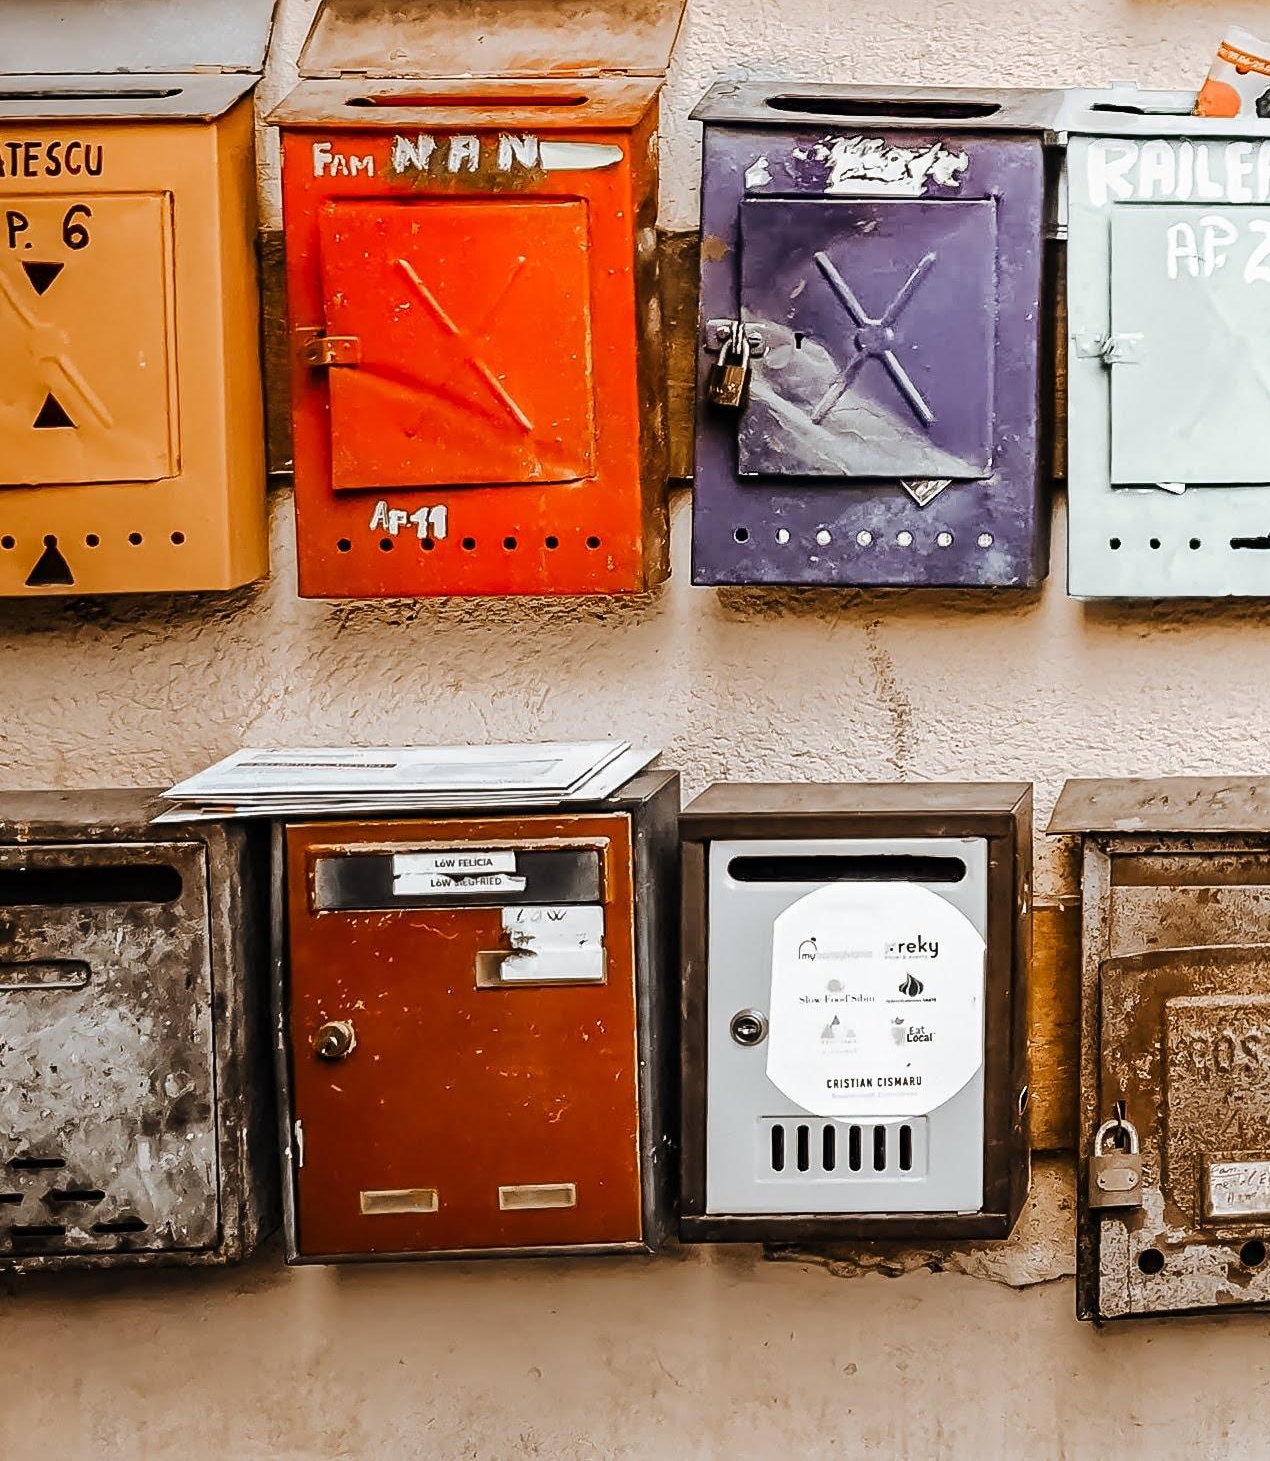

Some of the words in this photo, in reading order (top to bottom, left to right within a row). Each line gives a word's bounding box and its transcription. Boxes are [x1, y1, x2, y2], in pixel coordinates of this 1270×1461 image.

[62, 203, 93, 251] 6
[458, 858, 494, 868] FELICIA
[909, 1026, 925, 1036] Eat
[906, 1033, 933, 1043] Local
[826, 1078, 873, 1089] CRISTIAN
[877, 1076, 922, 1088] CISMARU
